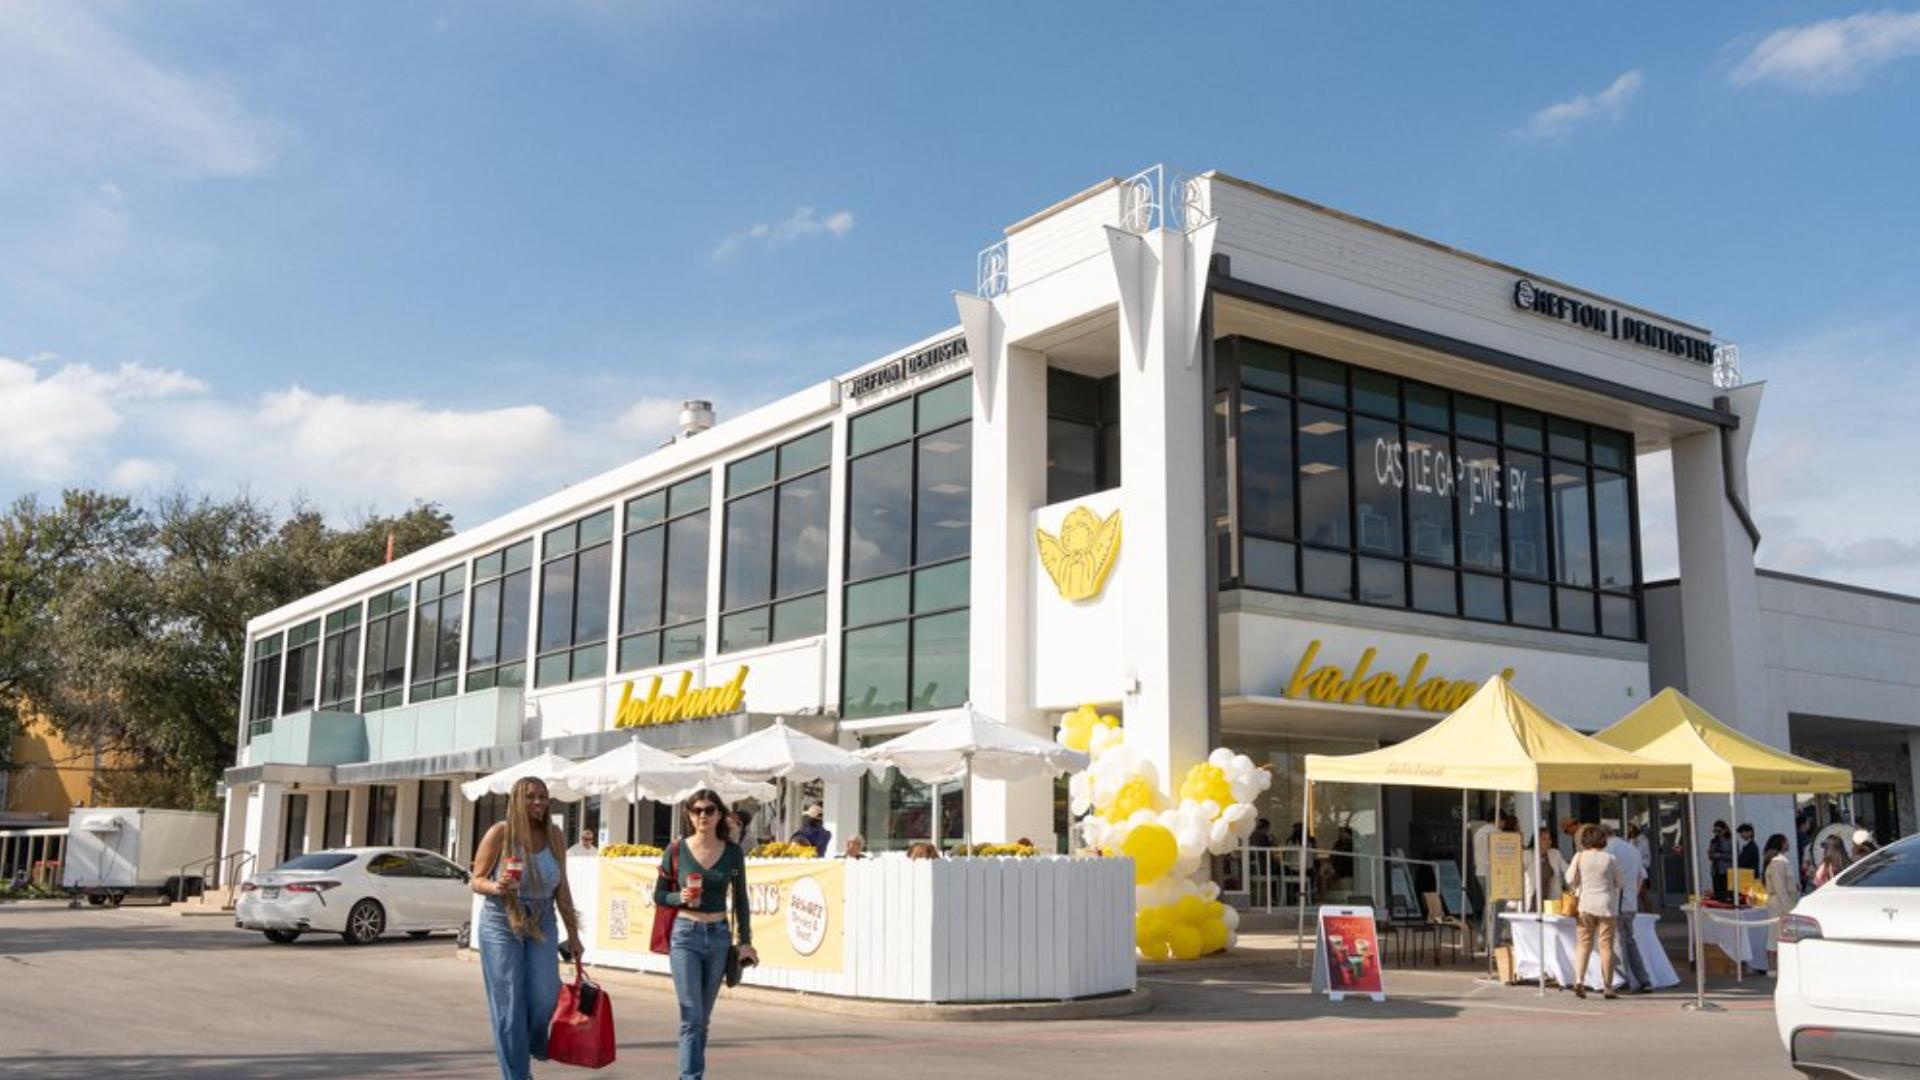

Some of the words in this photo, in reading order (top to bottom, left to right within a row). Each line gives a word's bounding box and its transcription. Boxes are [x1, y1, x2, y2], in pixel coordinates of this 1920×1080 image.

[1533, 287, 1606, 332] HEFTON
[1623, 317, 1716, 364] DENTISTRY
[1284, 639, 1515, 711] lalalan
